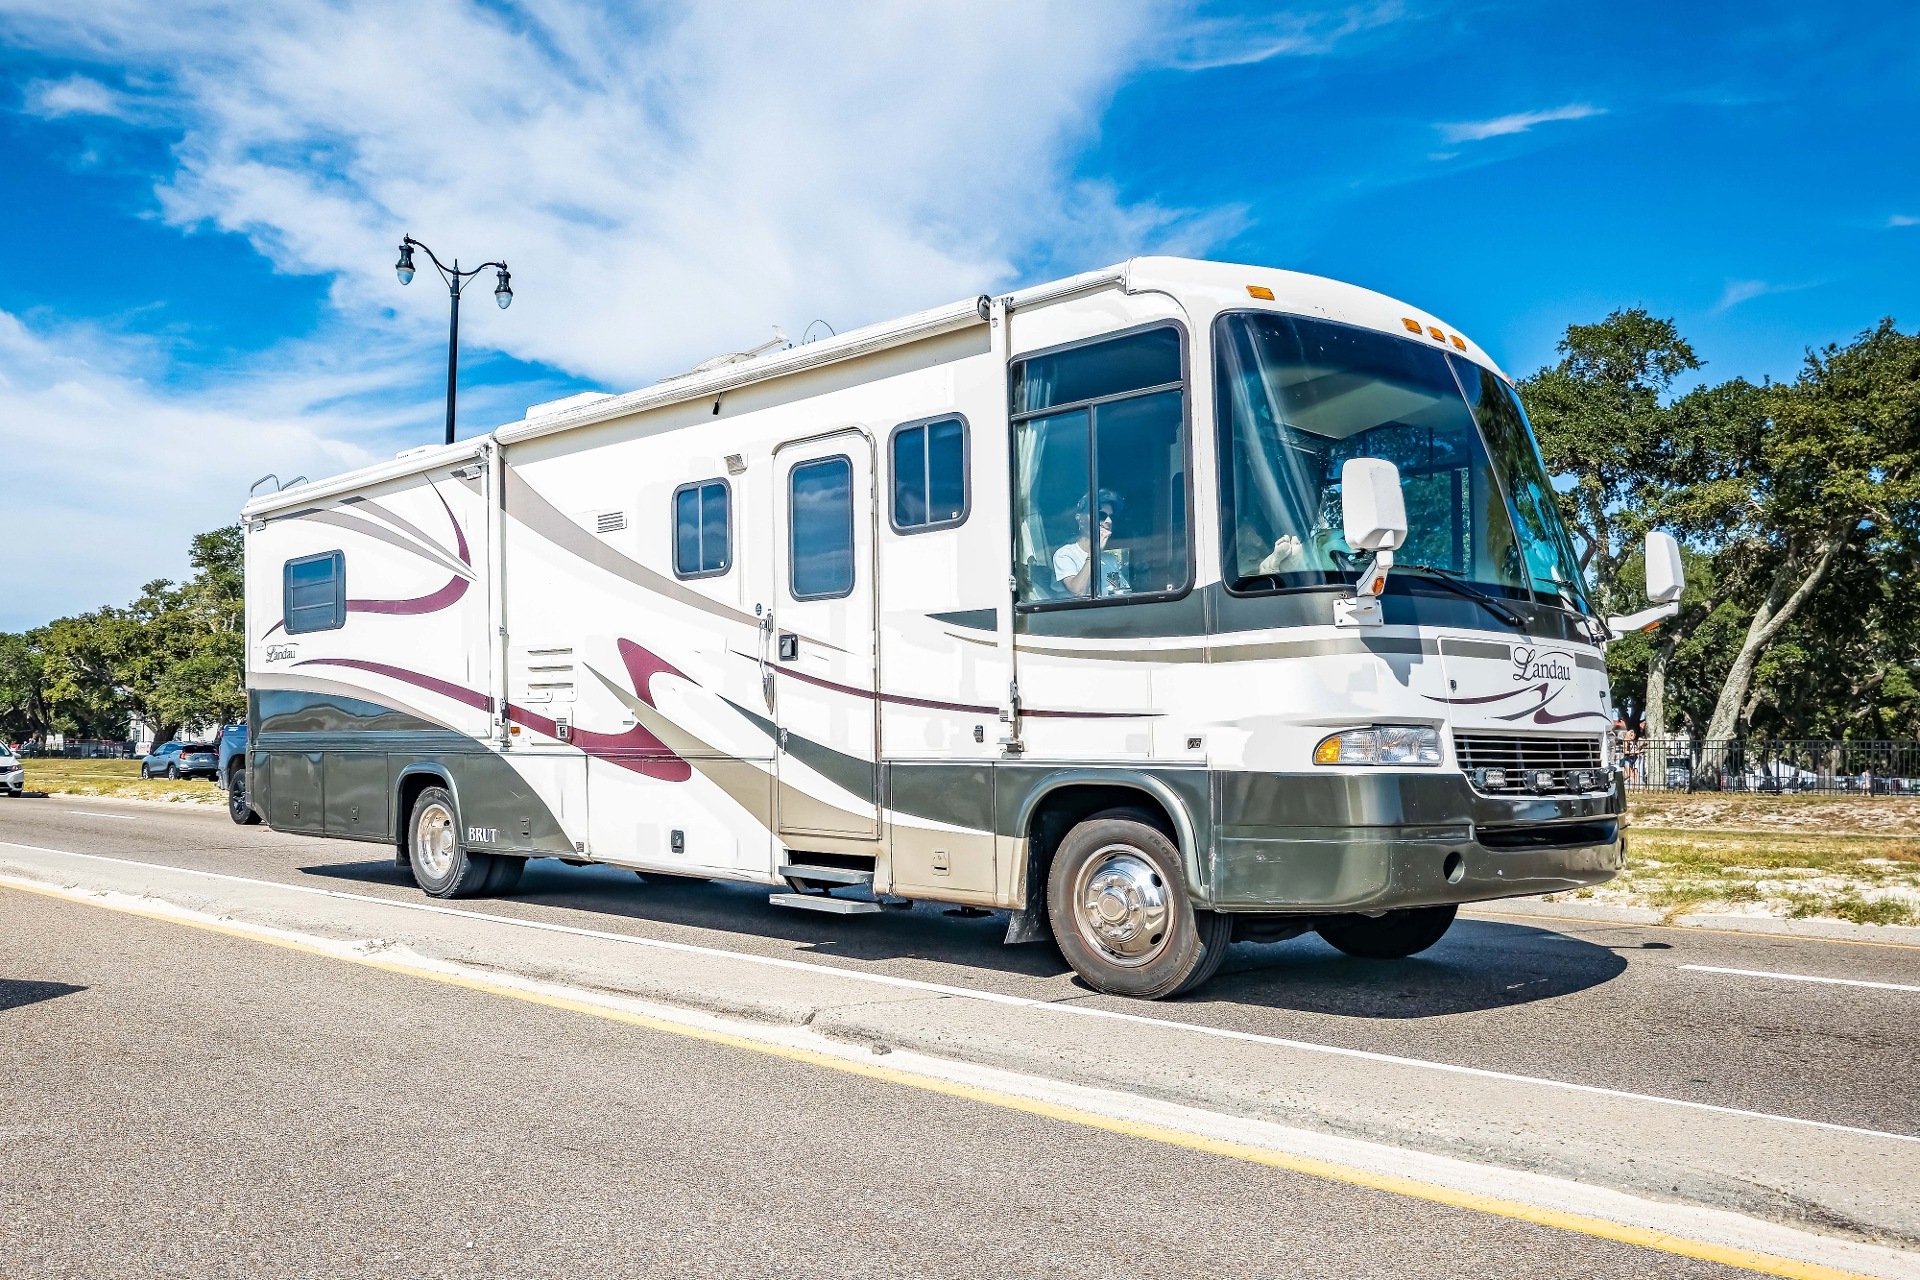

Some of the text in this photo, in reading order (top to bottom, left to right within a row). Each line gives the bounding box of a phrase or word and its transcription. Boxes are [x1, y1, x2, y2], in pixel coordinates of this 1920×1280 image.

[265, 644, 296, 664] Landau
[1512, 646, 1571, 682] Landau
[468, 827, 497, 843] BRUT
